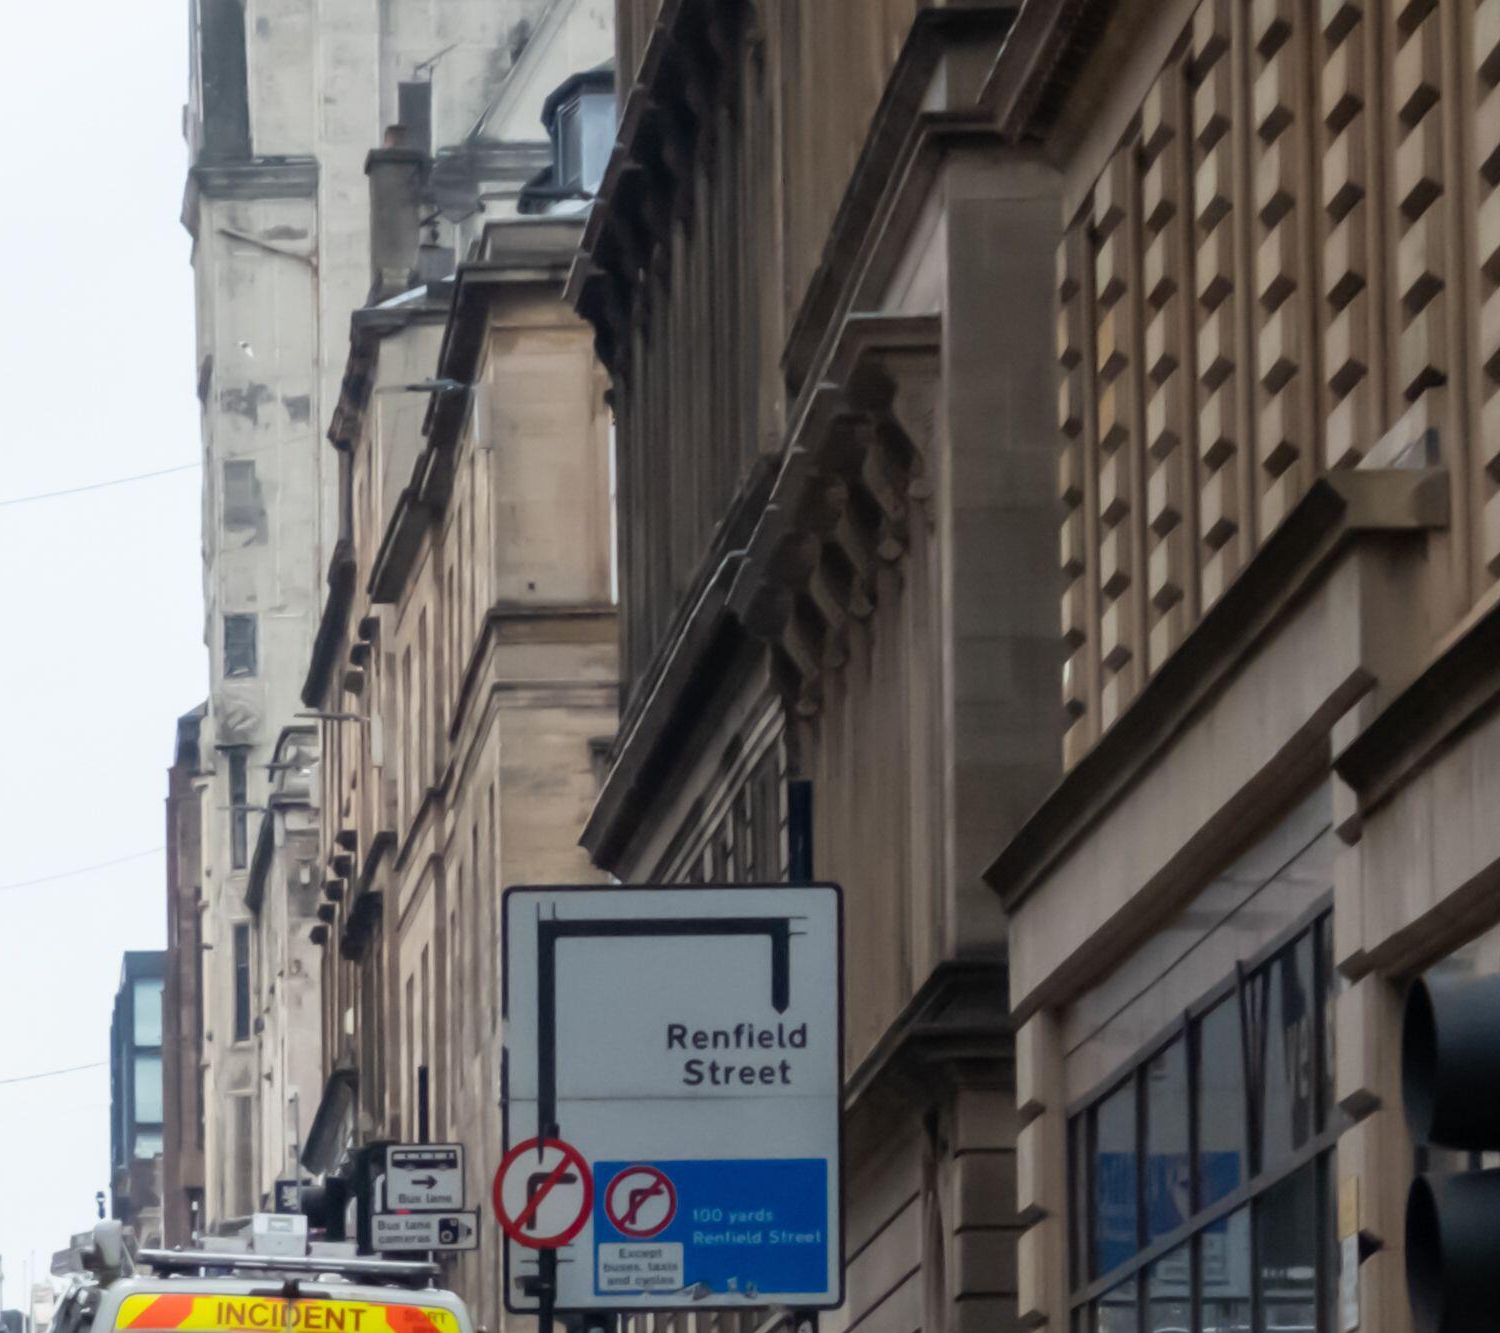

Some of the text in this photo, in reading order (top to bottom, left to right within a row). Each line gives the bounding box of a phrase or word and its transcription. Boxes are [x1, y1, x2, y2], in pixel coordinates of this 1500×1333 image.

[667, 1022, 808, 1050] Renfield
[683, 1058, 792, 1086] Street
[399, 1194, 421, 1204] Bus
[693, 1208, 774, 1225] 100 yards
[378, 1220, 432, 1231] Bus lane
[378, 1235, 431, 1244] cameras
[693, 1230, 821, 1245] Renfield Street
[619, 1248, 663, 1262] Except
[648, 1262, 679, 1272] taxis
[607, 1275, 631, 1286] and
[216, 1302, 367, 1332] INCIDENT
